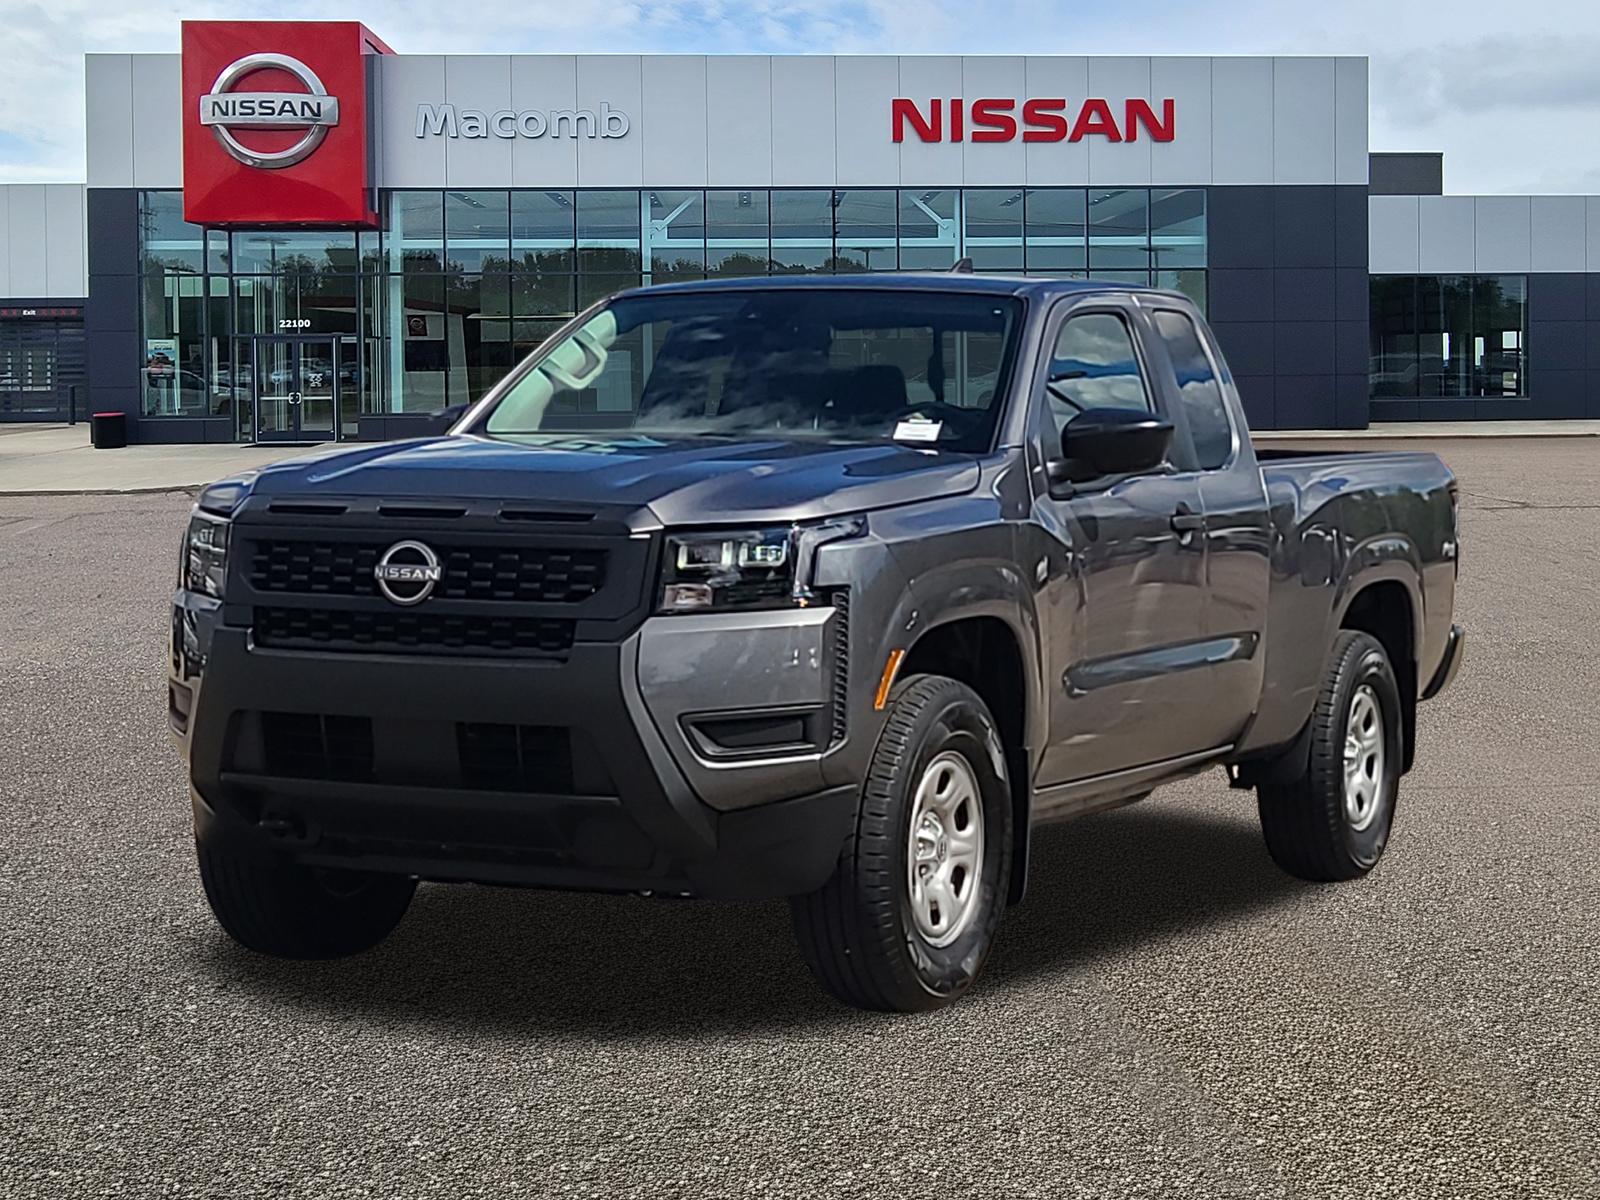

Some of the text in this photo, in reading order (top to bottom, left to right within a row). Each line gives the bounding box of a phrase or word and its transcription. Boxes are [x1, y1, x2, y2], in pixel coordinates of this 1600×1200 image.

[212, 100, 322, 118] NISSAN
[415, 102, 630, 139] Macomb
[892, 98, 1175, 143] NISSAN
[279, 319, 311, 328] 22100
[375, 567, 439, 580] NISSAN
